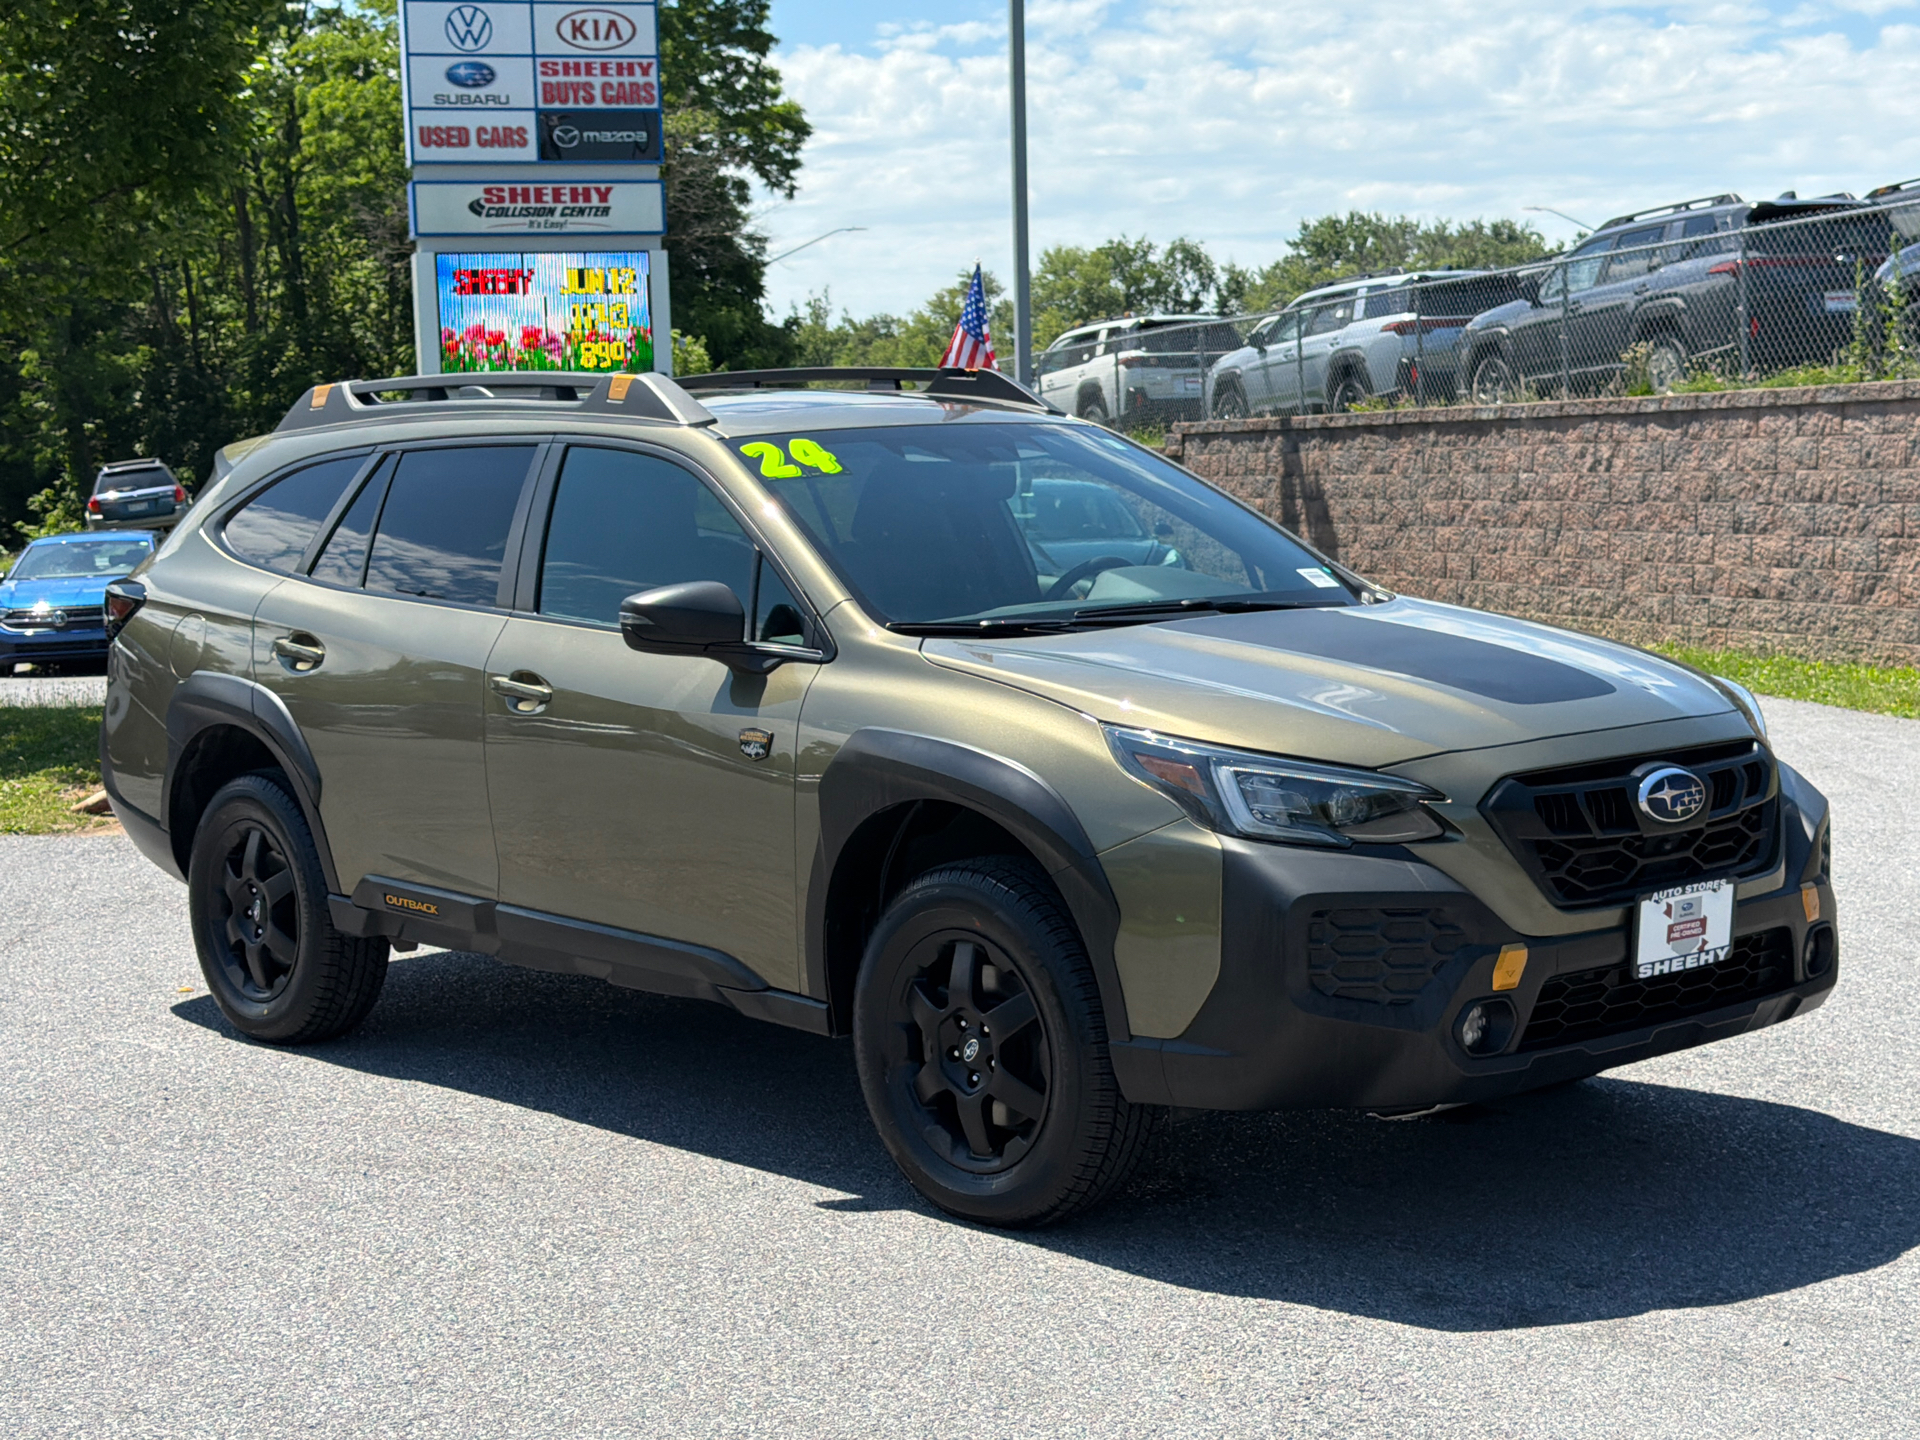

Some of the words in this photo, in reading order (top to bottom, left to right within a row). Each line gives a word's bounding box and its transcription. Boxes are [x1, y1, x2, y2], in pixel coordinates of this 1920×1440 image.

[570, 19, 624, 41] KIA
[540, 61, 654, 77] SHEEHY
[433, 94, 510, 105] SUBARU
[542, 82, 595, 105] BUYS
[601, 82, 655, 105] CARS
[419, 126, 470, 147] USED
[476, 126, 528, 147] CARS
[583, 131, 647, 143] mazda
[483, 186, 613, 204] SHEEHY
[485, 206, 557, 218] COLLISION
[559, 206, 611, 217] CENTER
[543, 219, 568, 230] Easy!
[454, 268, 534, 295] SHEEHY
[560, 268, 605, 294] JUN
[740, 438, 843, 479] 24
[1651, 888, 1682, 901] AUTO
[1685, 879, 1727, 892] STORES
[385, 895, 439, 914] OUTBACK
[1670, 927, 1702, 939] PRE-OWNED
[1673, 921, 1701, 932] CERTIFIED
[1638, 946, 1730, 979] SHEEHY
